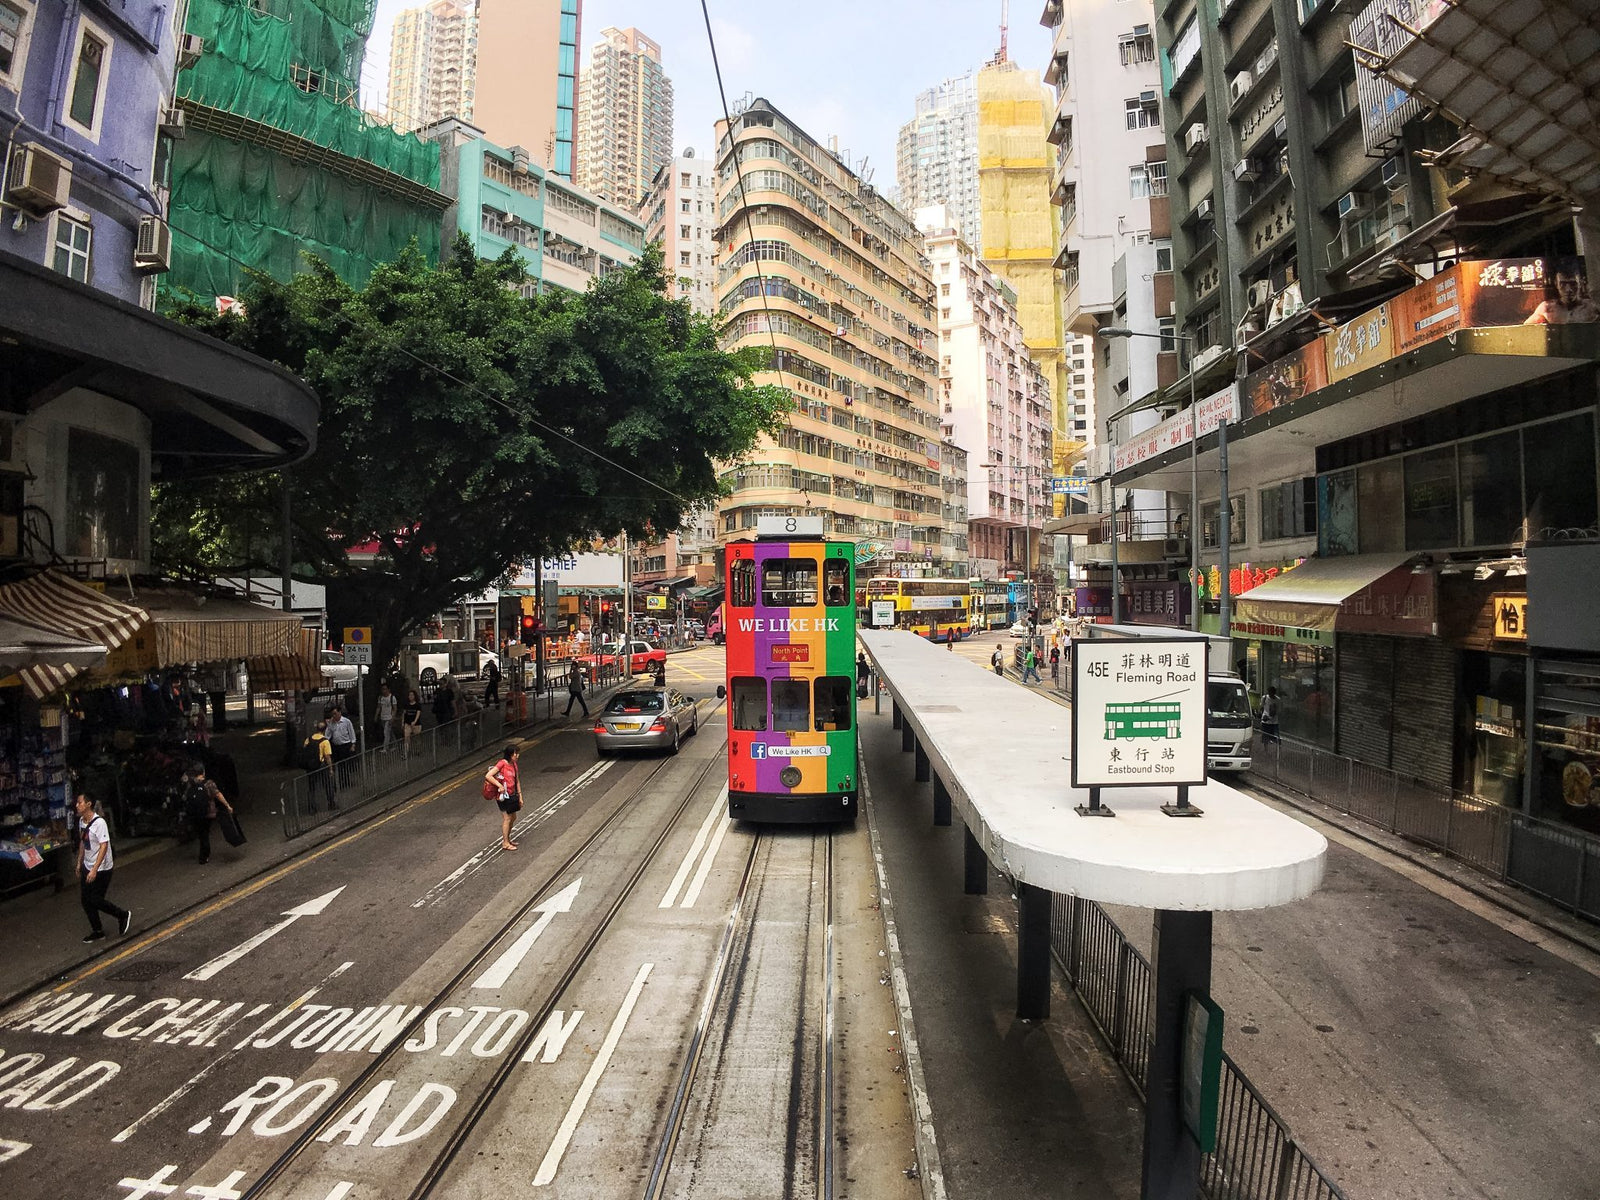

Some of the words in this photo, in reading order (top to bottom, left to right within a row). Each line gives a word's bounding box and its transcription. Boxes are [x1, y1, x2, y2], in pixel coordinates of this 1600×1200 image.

[785, 518, 797, 532] 8
[837, 548, 843, 556] 8
[738, 618, 765, 632] WE
[769, 618, 809, 632] LIKE
[814, 618, 840, 632] HK
[350, 654, 367, 663] 全日
[1121, 653, 1192, 669] 菲林明道
[1087, 662, 1110, 678] 45E
[1116, 672, 1163, 685] Fleming
[1166, 672, 1197, 682] Road
[1109, 747, 1175, 762] 東行站
[1107, 765, 1153, 774] Eastbound
[1154, 764, 1175, 774] Stop
[252, 1003, 584, 1064] JOHNSTON
[0, 1048, 122, 1111] OAD
[188, 1075, 457, 1148] ROAD
